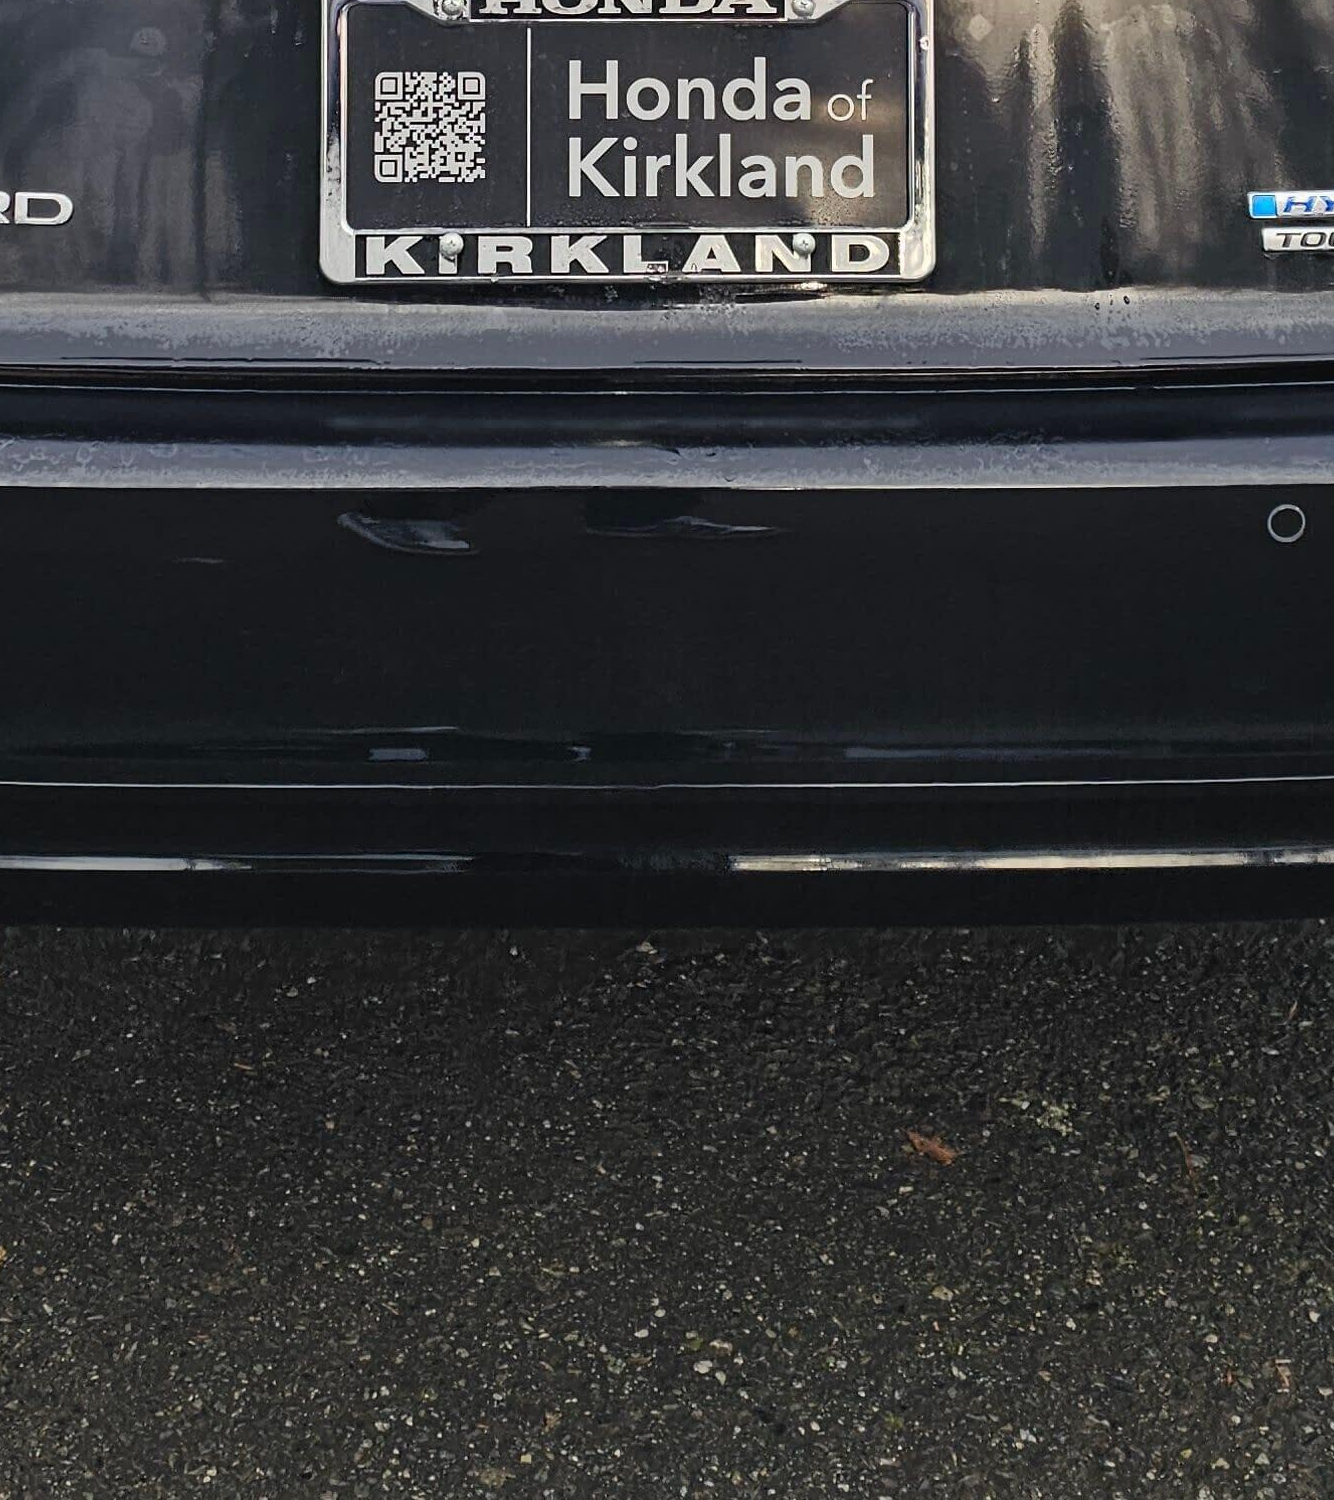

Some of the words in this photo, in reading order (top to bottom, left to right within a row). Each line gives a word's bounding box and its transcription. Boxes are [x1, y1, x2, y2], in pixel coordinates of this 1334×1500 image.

[568, 56, 811, 122] Honda
[827, 78, 873, 122] of
[568, 133, 874, 199] Kirkland
[365, 234, 891, 276] KIRKLAND
